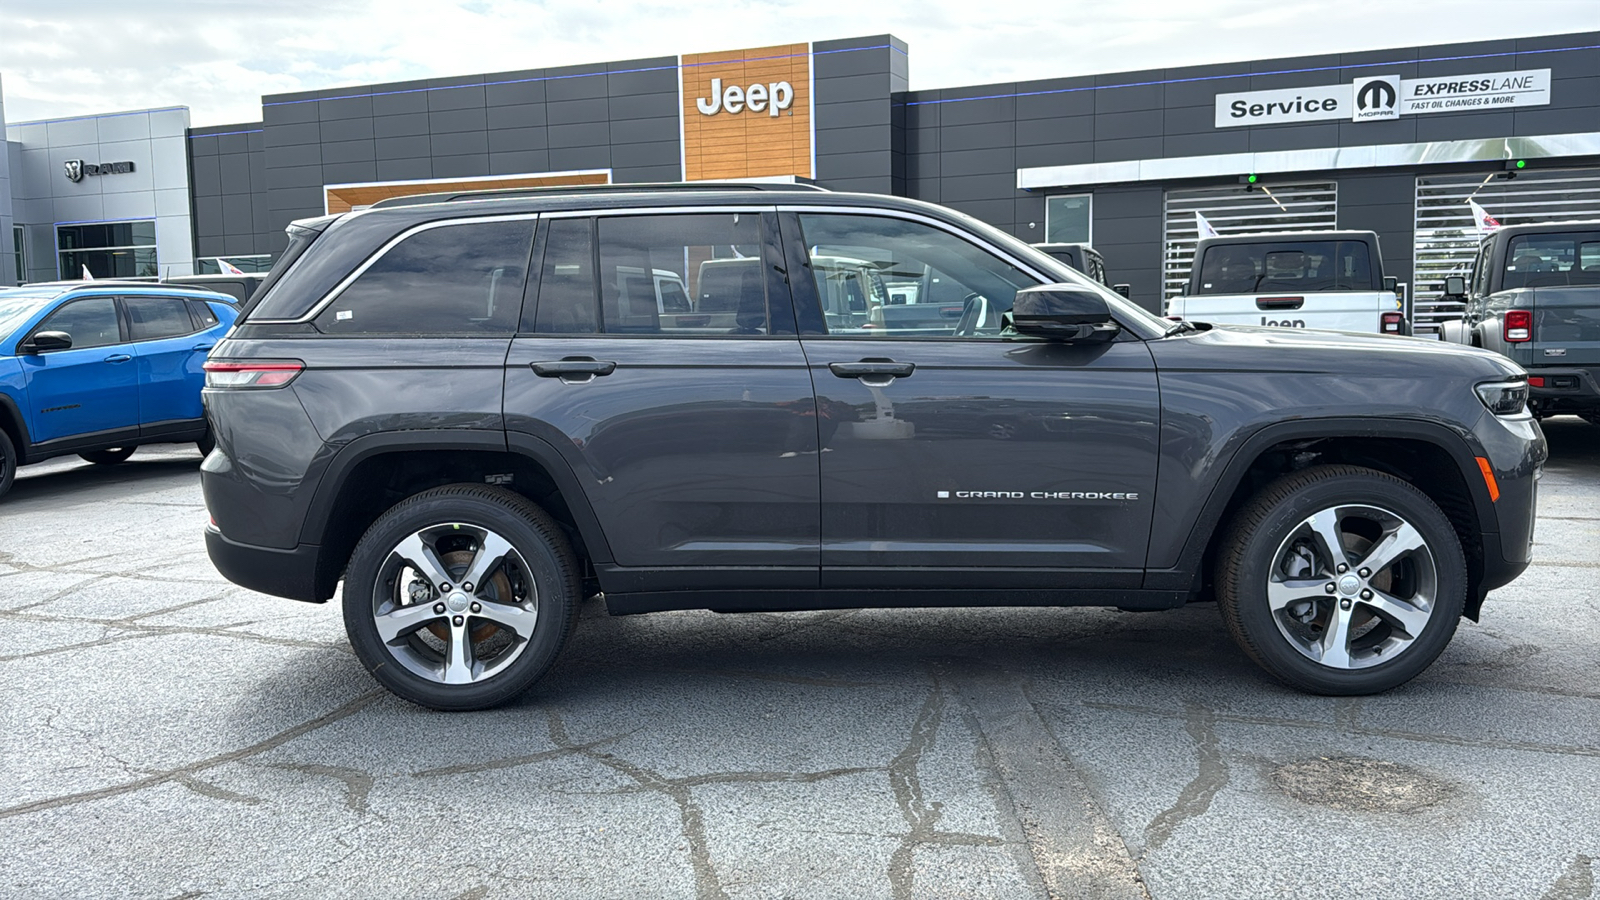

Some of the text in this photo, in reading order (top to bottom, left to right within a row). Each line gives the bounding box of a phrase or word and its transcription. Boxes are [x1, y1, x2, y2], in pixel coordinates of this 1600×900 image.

[1413, 75, 1534, 97] EXPRESSLANE
[696, 78, 794, 117] Jeep
[1410, 95, 1516, 110] FAST OIL CHANGES & MORE
[1230, 96, 1338, 119] Service
[1358, 110, 1395, 118] MOPAR
[84, 161, 134, 176] RAM
[955, 491, 1139, 500] GRAND CHEROKEE
